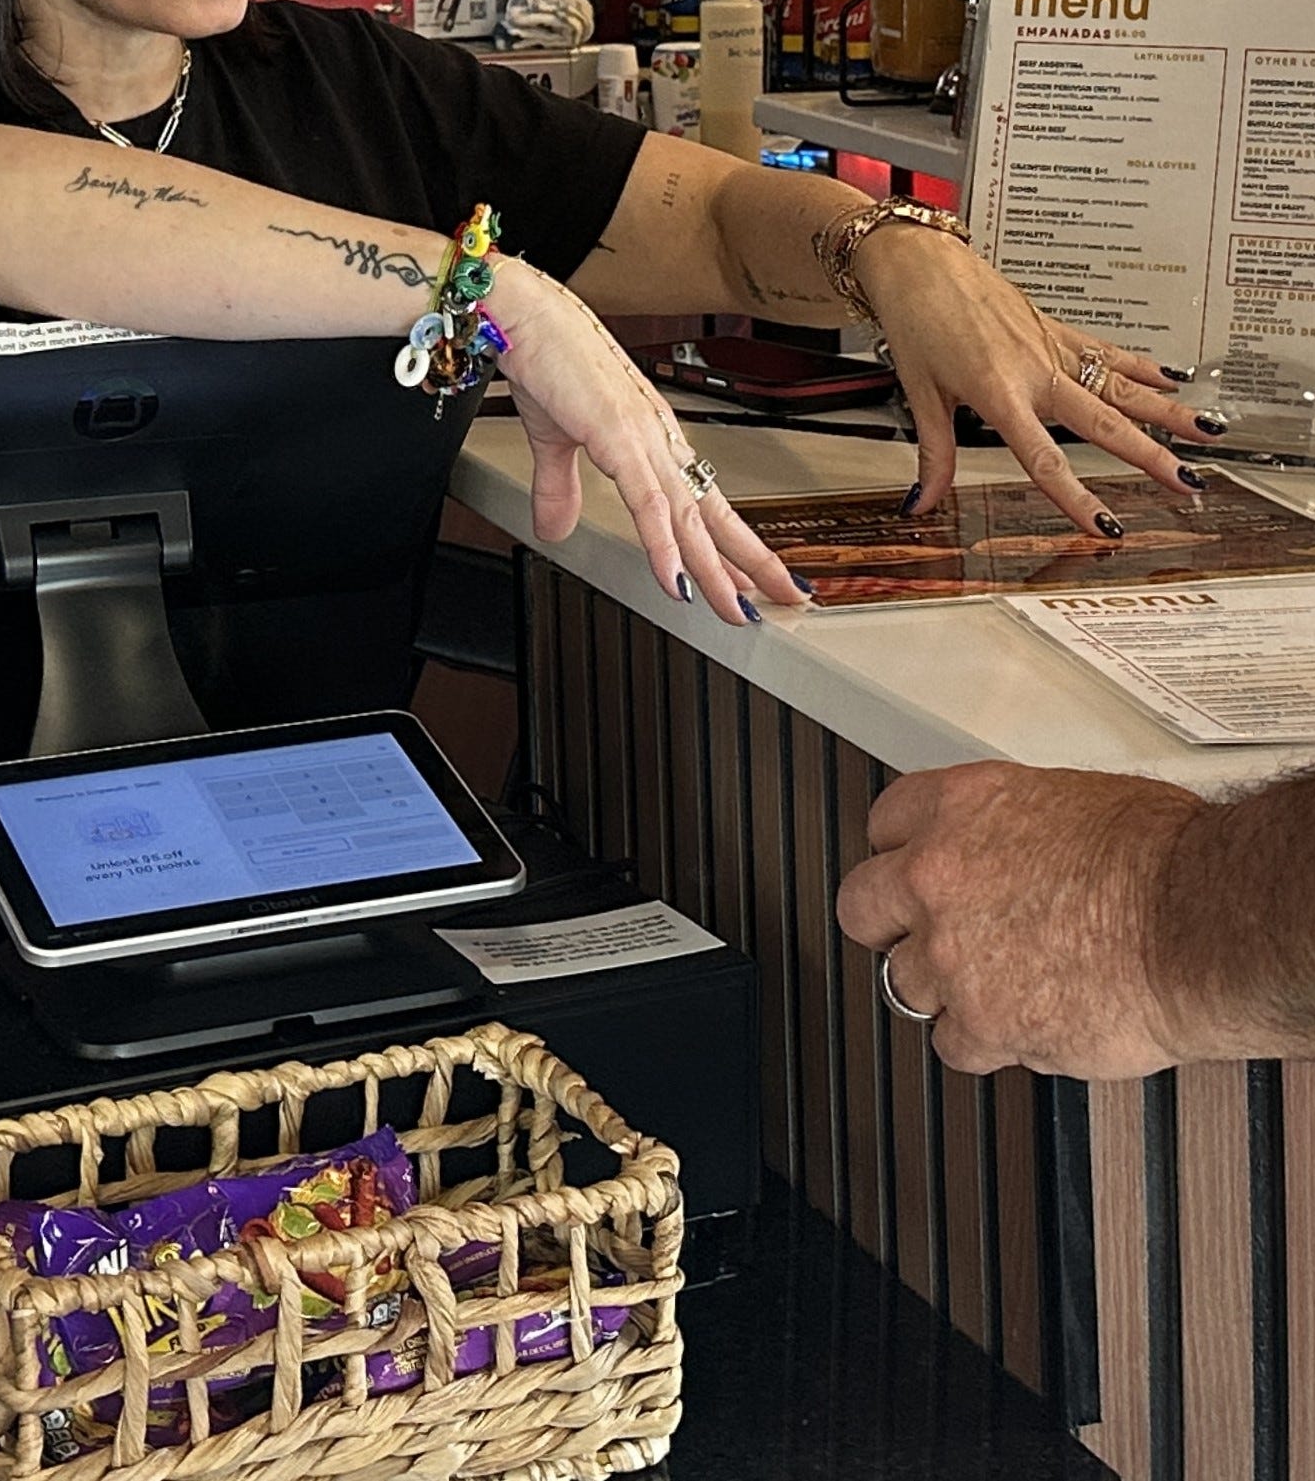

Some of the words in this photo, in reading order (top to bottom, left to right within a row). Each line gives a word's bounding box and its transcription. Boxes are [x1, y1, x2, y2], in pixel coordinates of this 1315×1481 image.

[1017, 26, 1112, 40] EMPANADAS
[1166, 53, 1205, 63] LOVERS
[1254, 56, 1297, 67] OTHER
[1157, 160, 1196, 170] LOVERS
[1238, 238, 1282, 250] SWEET
[1234, 288, 1282, 300] COFFEE
[1230, 322, 1295, 336] ESPRESSO
[49, 336, 76, 350] more
[756, 518, 838, 532] OMBO
[1039, 592, 1218, 610] menu
[85, 870, 122, 883] every
[126, 865, 153, 877] 100
